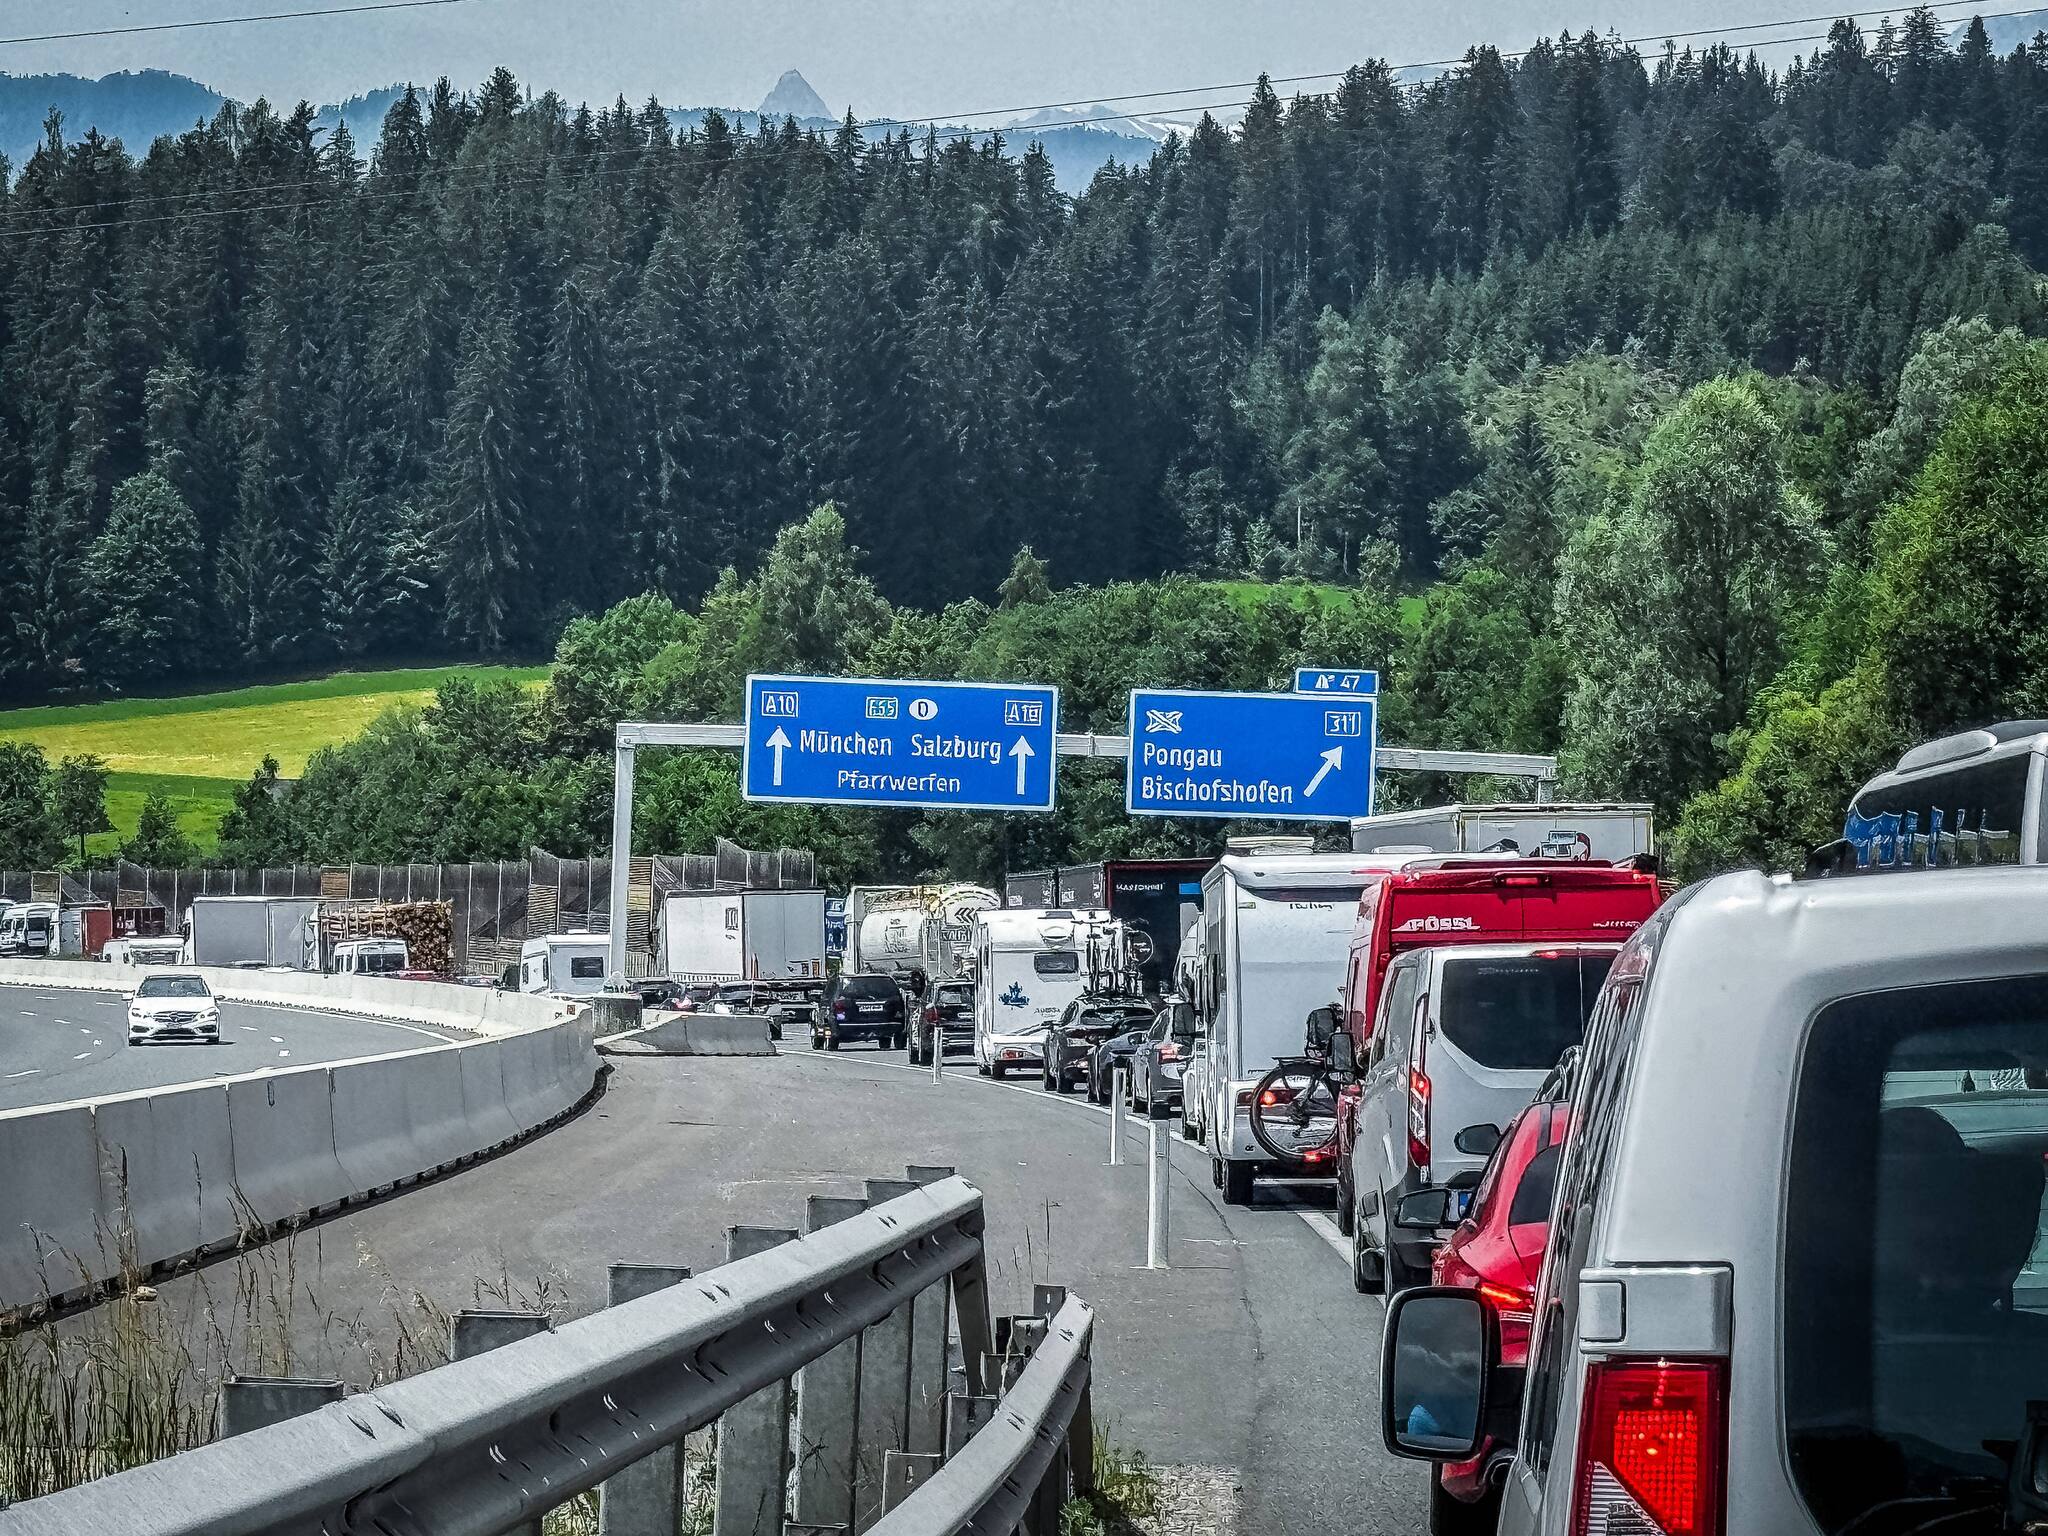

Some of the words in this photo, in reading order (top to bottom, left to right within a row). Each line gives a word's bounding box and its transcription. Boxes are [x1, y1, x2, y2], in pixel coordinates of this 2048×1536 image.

[1340, 675, 1360, 692] 47
[765, 695, 795, 715] A10
[917, 701, 929, 718] D
[1329, 714, 1356, 734] 311
[799, 729, 892, 756] München
[911, 733, 1001, 765] Salzburg
[1143, 742, 1222, 771] Pongau
[838, 770, 961, 793] Pfarrwerfen
[1141, 774, 1293, 804] Bischofshofen
